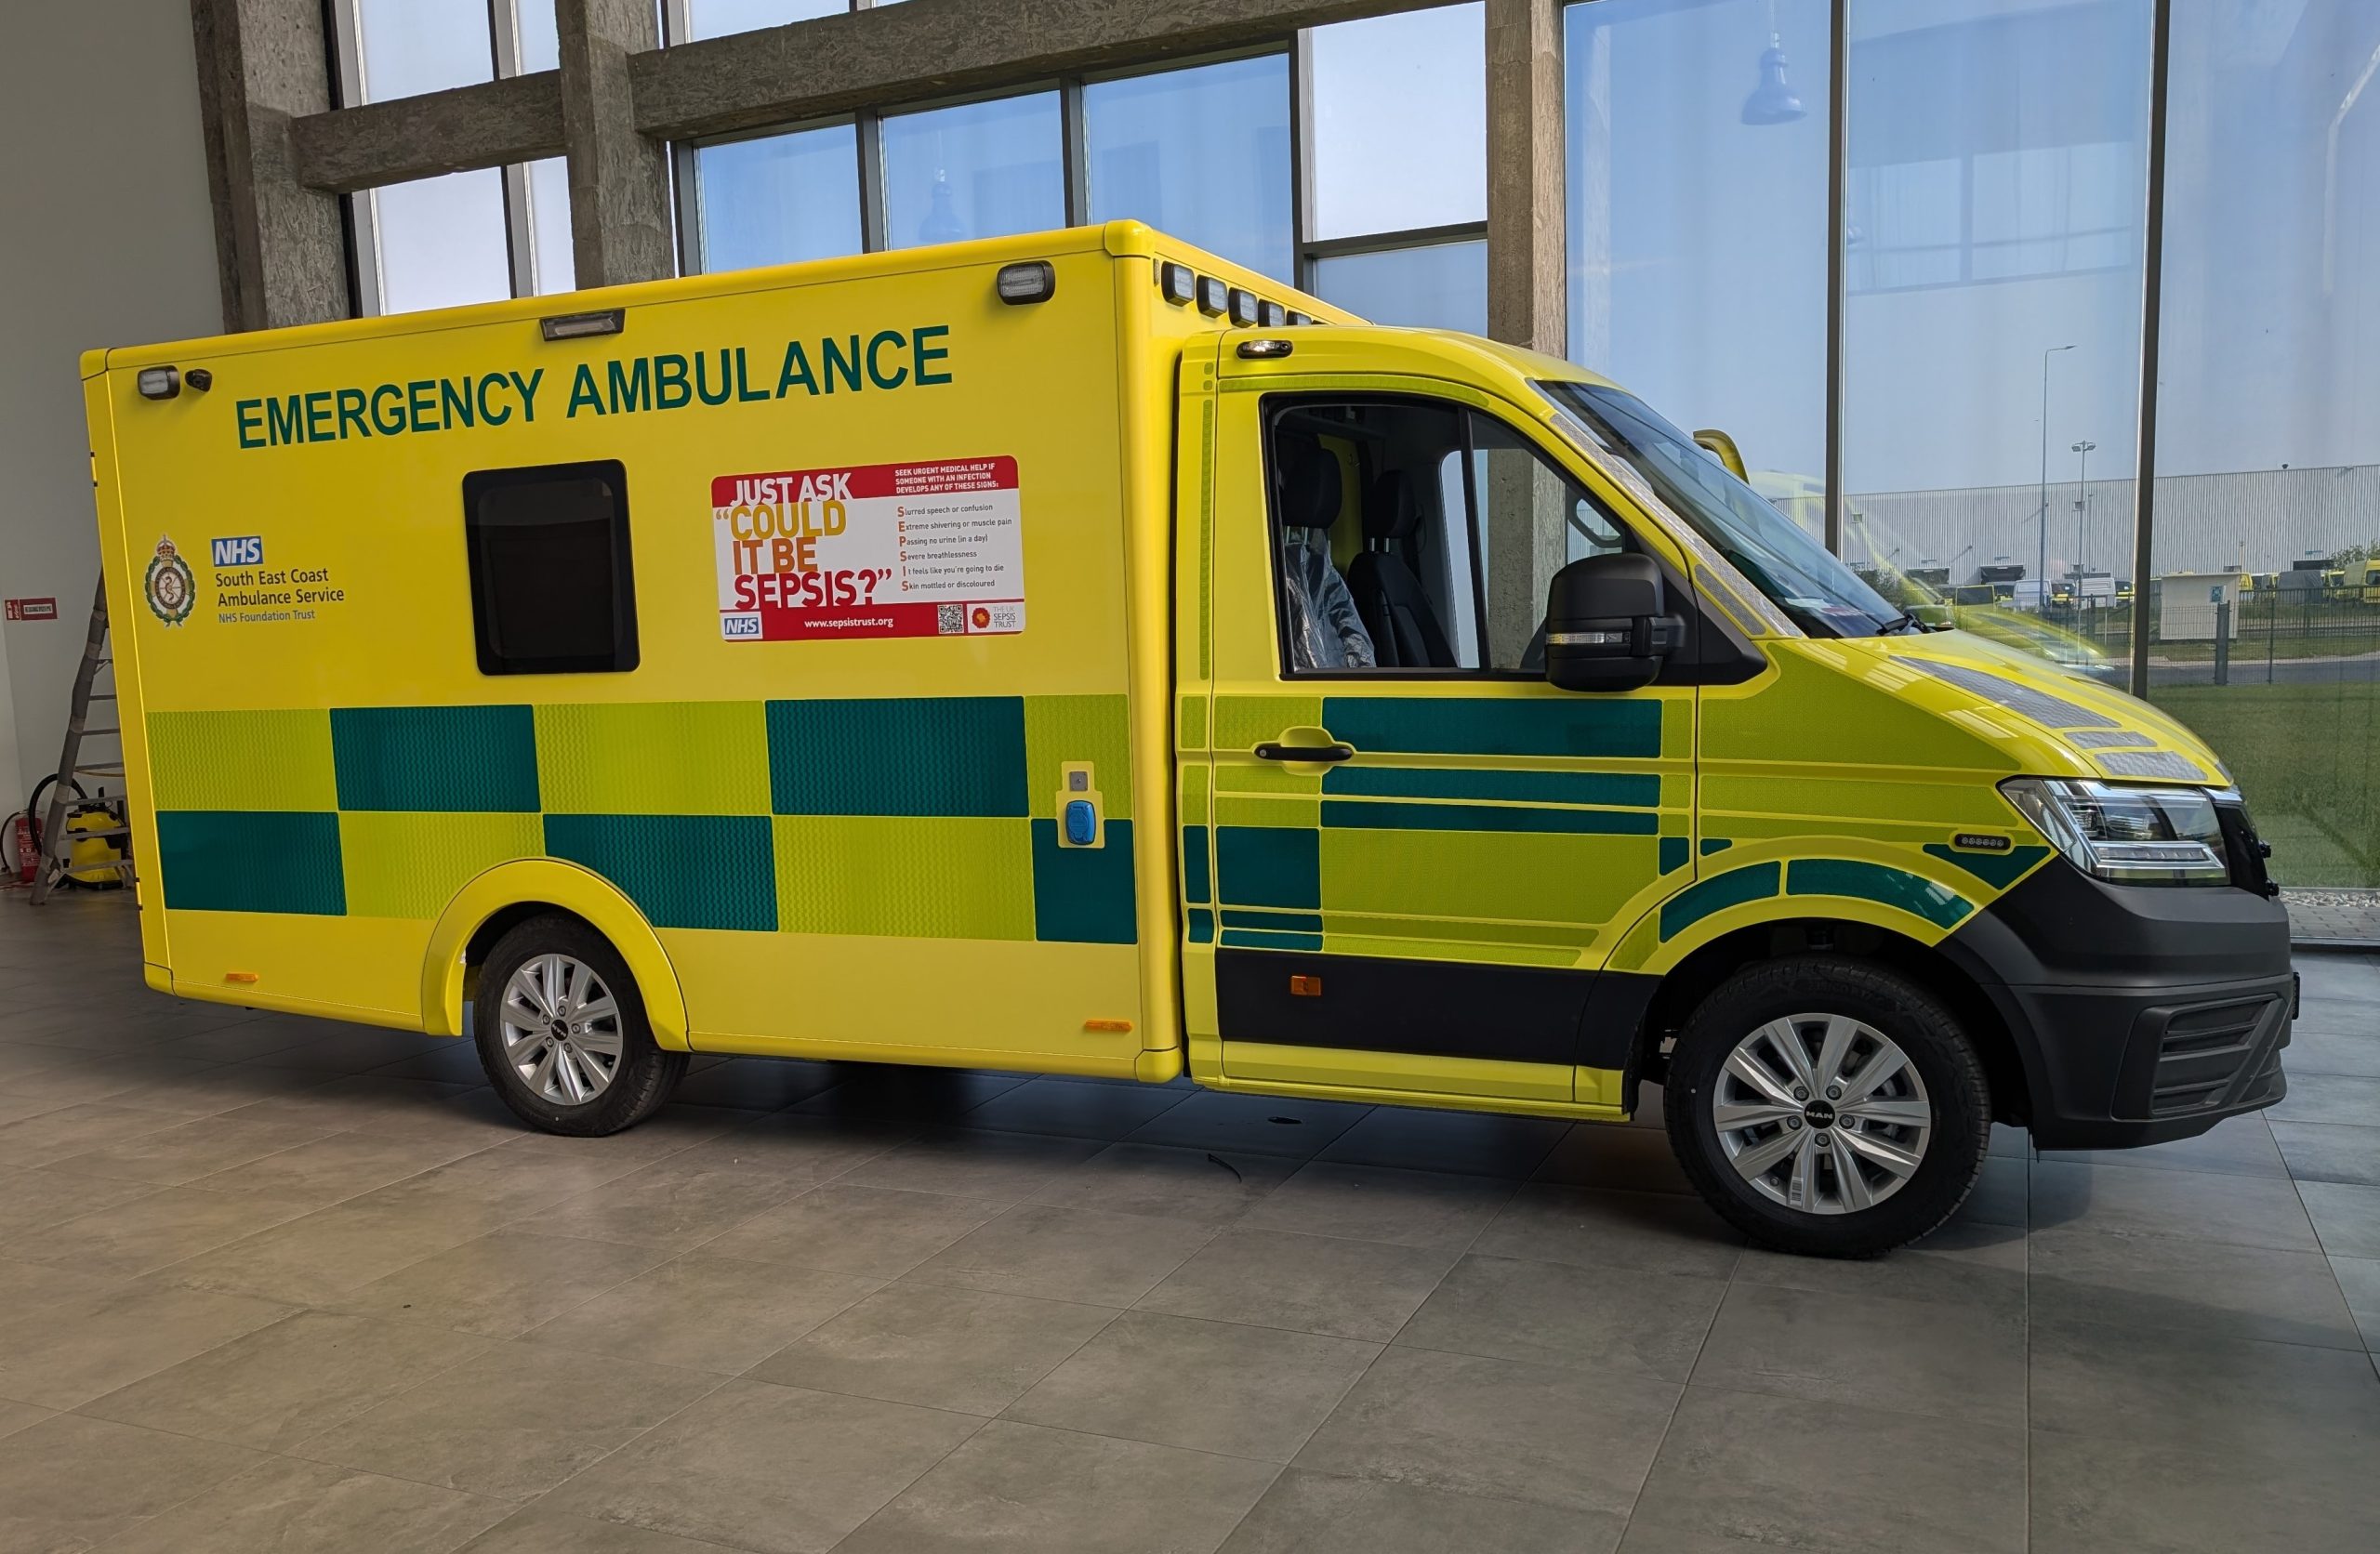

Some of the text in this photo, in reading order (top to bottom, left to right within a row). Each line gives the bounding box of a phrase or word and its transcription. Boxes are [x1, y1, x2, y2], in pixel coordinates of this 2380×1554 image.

[235, 325, 954, 449] EMERGENCY AMBULANCE
[895, 468, 912, 477] SEEK
[913, 467, 939, 476] URGENT
[941, 465, 970, 473] MEDICAL
[971, 464, 987, 472] HELP
[895, 472, 991, 485] SOMEONE WITH AN INFECTION
[730, 472, 854, 507] JUST ASK
[896, 481, 998, 494] DEVELOPS ANY OF THESE SIGNS:
[897, 506, 925, 518] Slurred
[927, 507, 950, 517] speech
[960, 504, 993, 512] confusion
[898, 521, 929, 532] Extreme
[931, 520, 960, 530] shivering
[972, 519, 996, 527] muscle
[998, 518, 1012, 527] pain
[899, 535, 928, 547] Passing
[939, 535, 957, 544] urine
[958, 534, 967, 544] (in
[973, 533, 988, 544] day)
[214, 537, 261, 565] NHS
[733, 536, 818, 575] IT BE
[900, 550, 977, 561] Severe breathlessness
[912, 567, 929, 575] feels
[930, 566, 943, 574] like
[965, 564, 985, 575] going
[994, 563, 1005, 572] die
[216, 568, 329, 587] South East Coast
[902, 580, 919, 591] Skin
[920, 581, 946, 589] mottled
[956, 579, 996, 588] discoloured
[218, 586, 344, 607] Ambulance Service
[218, 610, 315, 624] NHS Foundation Trust
[804, 616, 893, 629] www.sepsistrust.org
[993, 612, 1016, 621] SEPSIS
[724, 617, 758, 635] NHS
[994, 620, 1016, 628] TRUST
[1805, 1111, 1833, 1119] MAN
